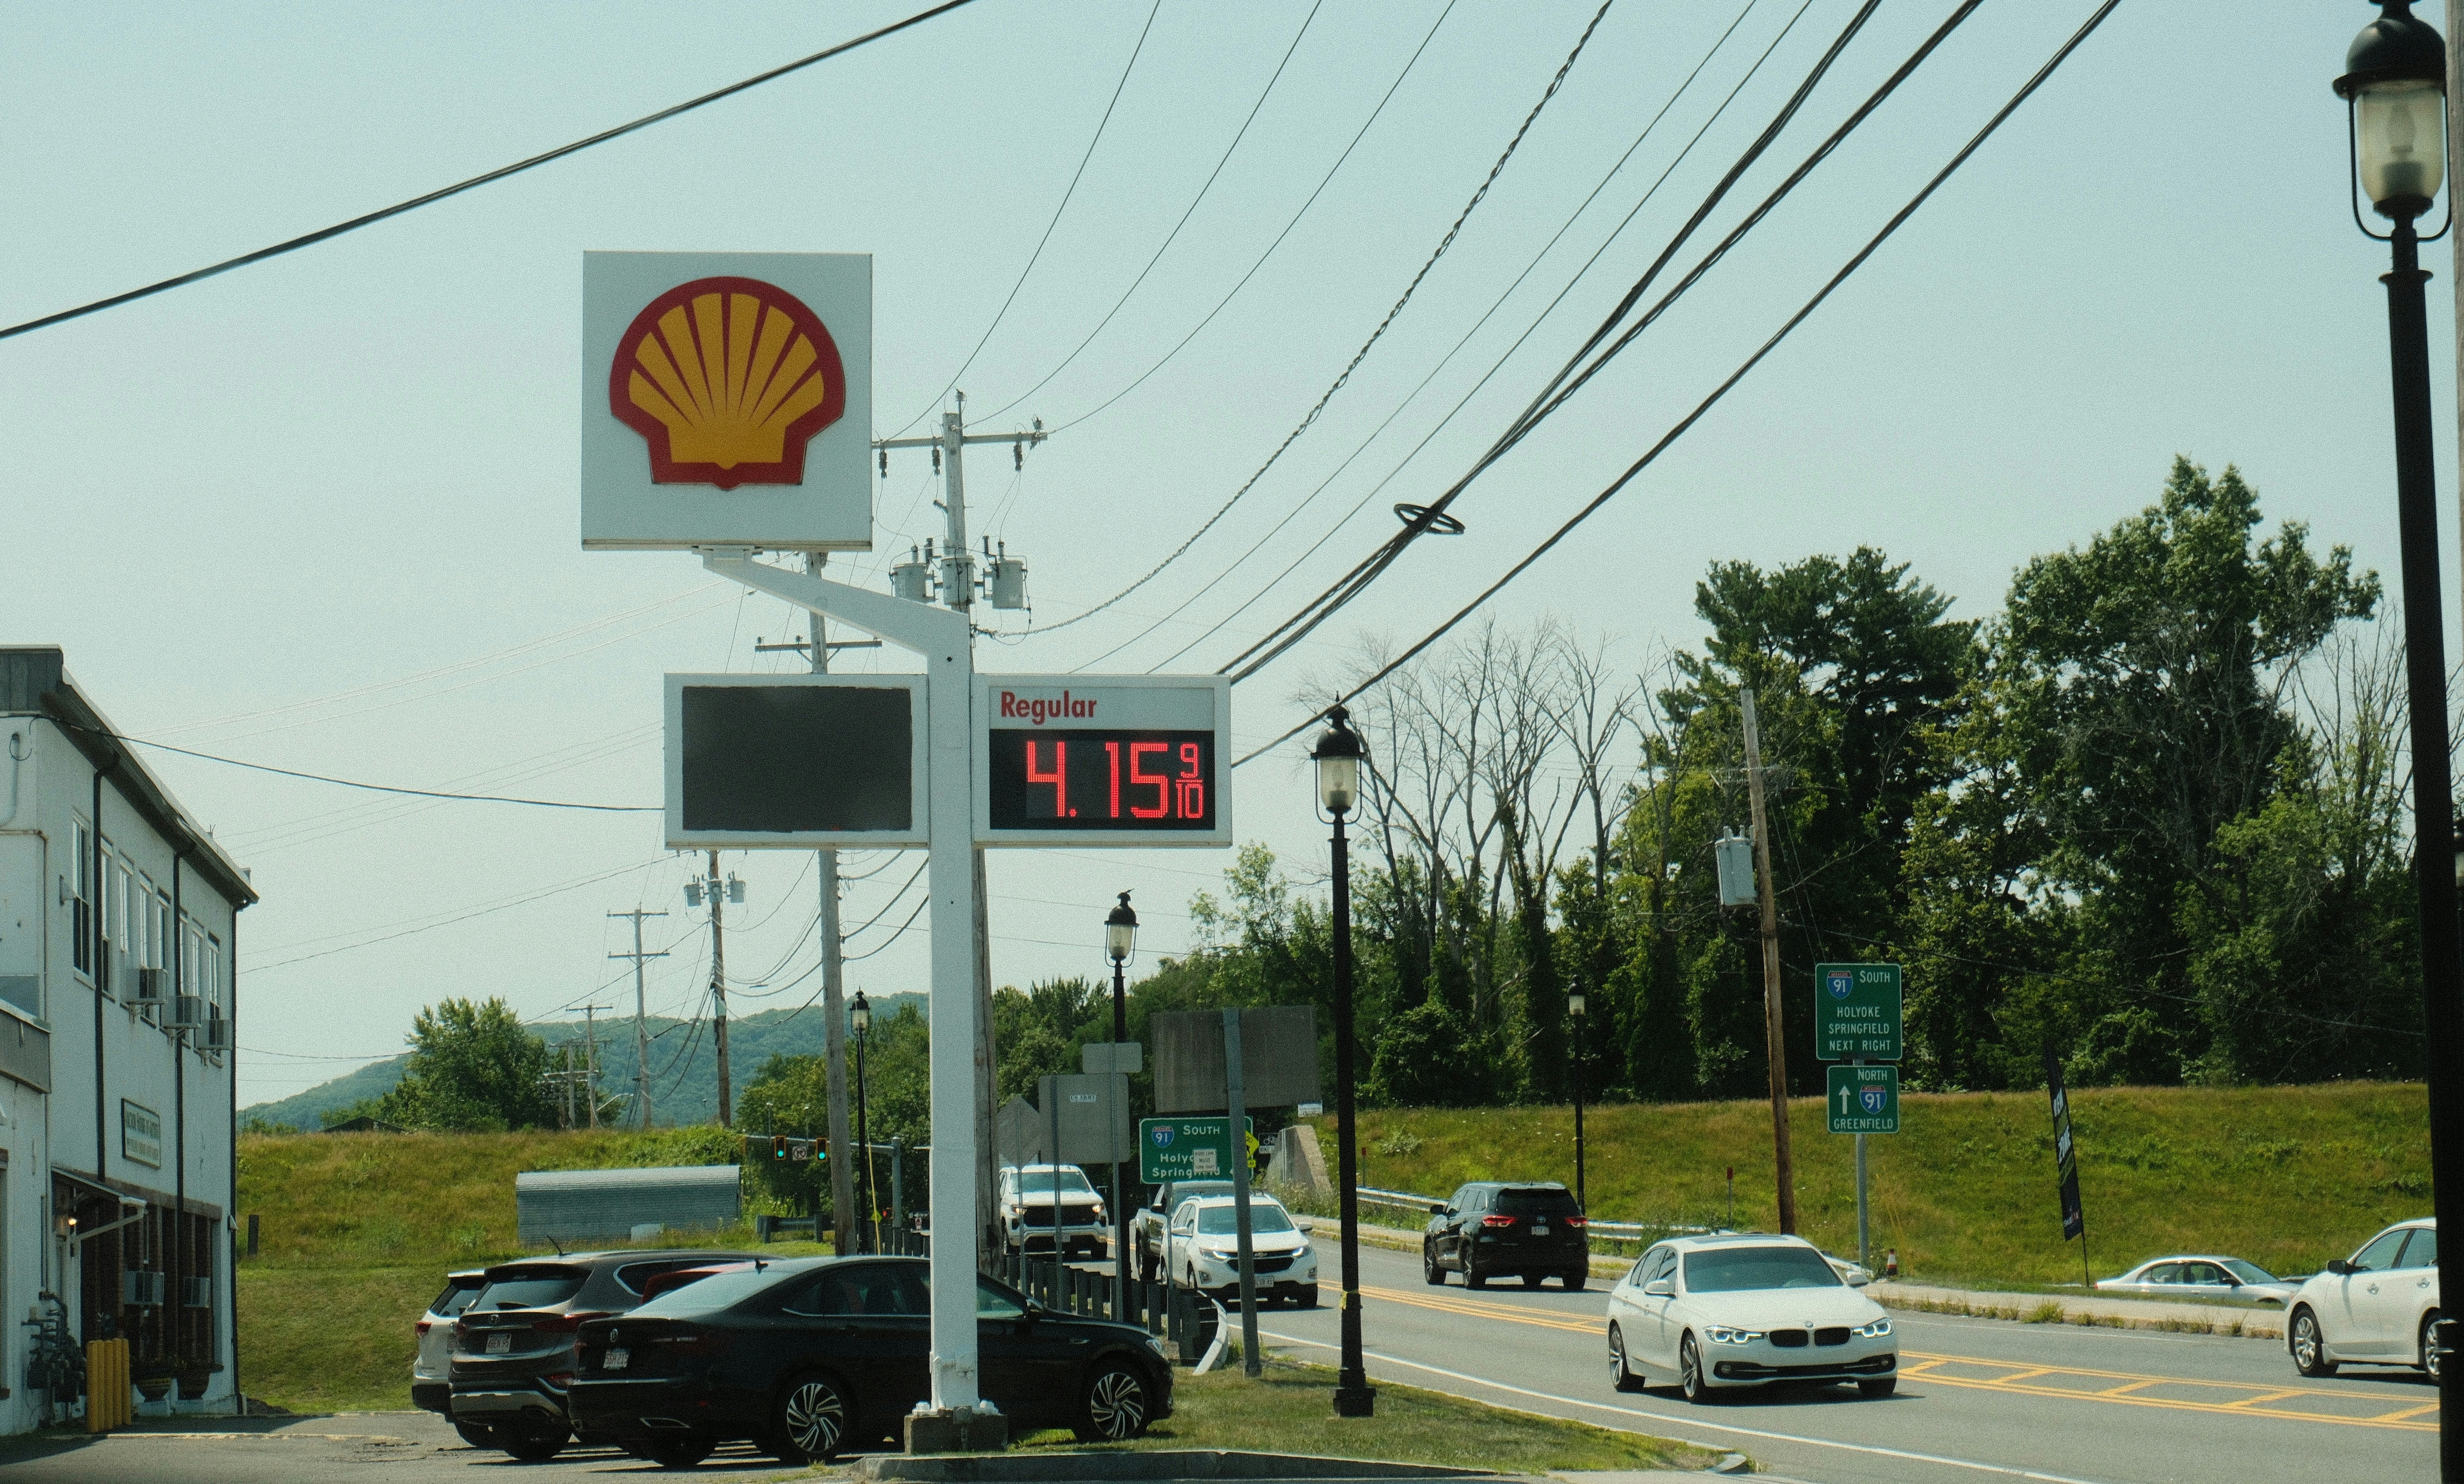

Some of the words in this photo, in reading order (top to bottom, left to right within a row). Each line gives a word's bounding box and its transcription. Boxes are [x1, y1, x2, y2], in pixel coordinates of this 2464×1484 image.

[1001, 690, 1097, 725] Regular
[1833, 979, 1846, 993] 91
[1860, 970, 1890, 983] SOUTH
[1837, 1007, 1880, 1017] HOLYOKE
[1829, 1023, 1889, 1034] SPRINGFIELD
[1829, 1040, 1854, 1051] NEXT
[1862, 1040, 1891, 1051] RIGHT
[1857, 1069, 1887, 1081] NORTH
[1865, 1093, 1880, 1109] 91
[1834, 1118, 1893, 1129] GREENFIELD
[1156, 1133, 1167, 1143] 91
[1183, 1125, 1220, 1135] SOUTH
[1160, 1153, 1193, 1164] Holyo
